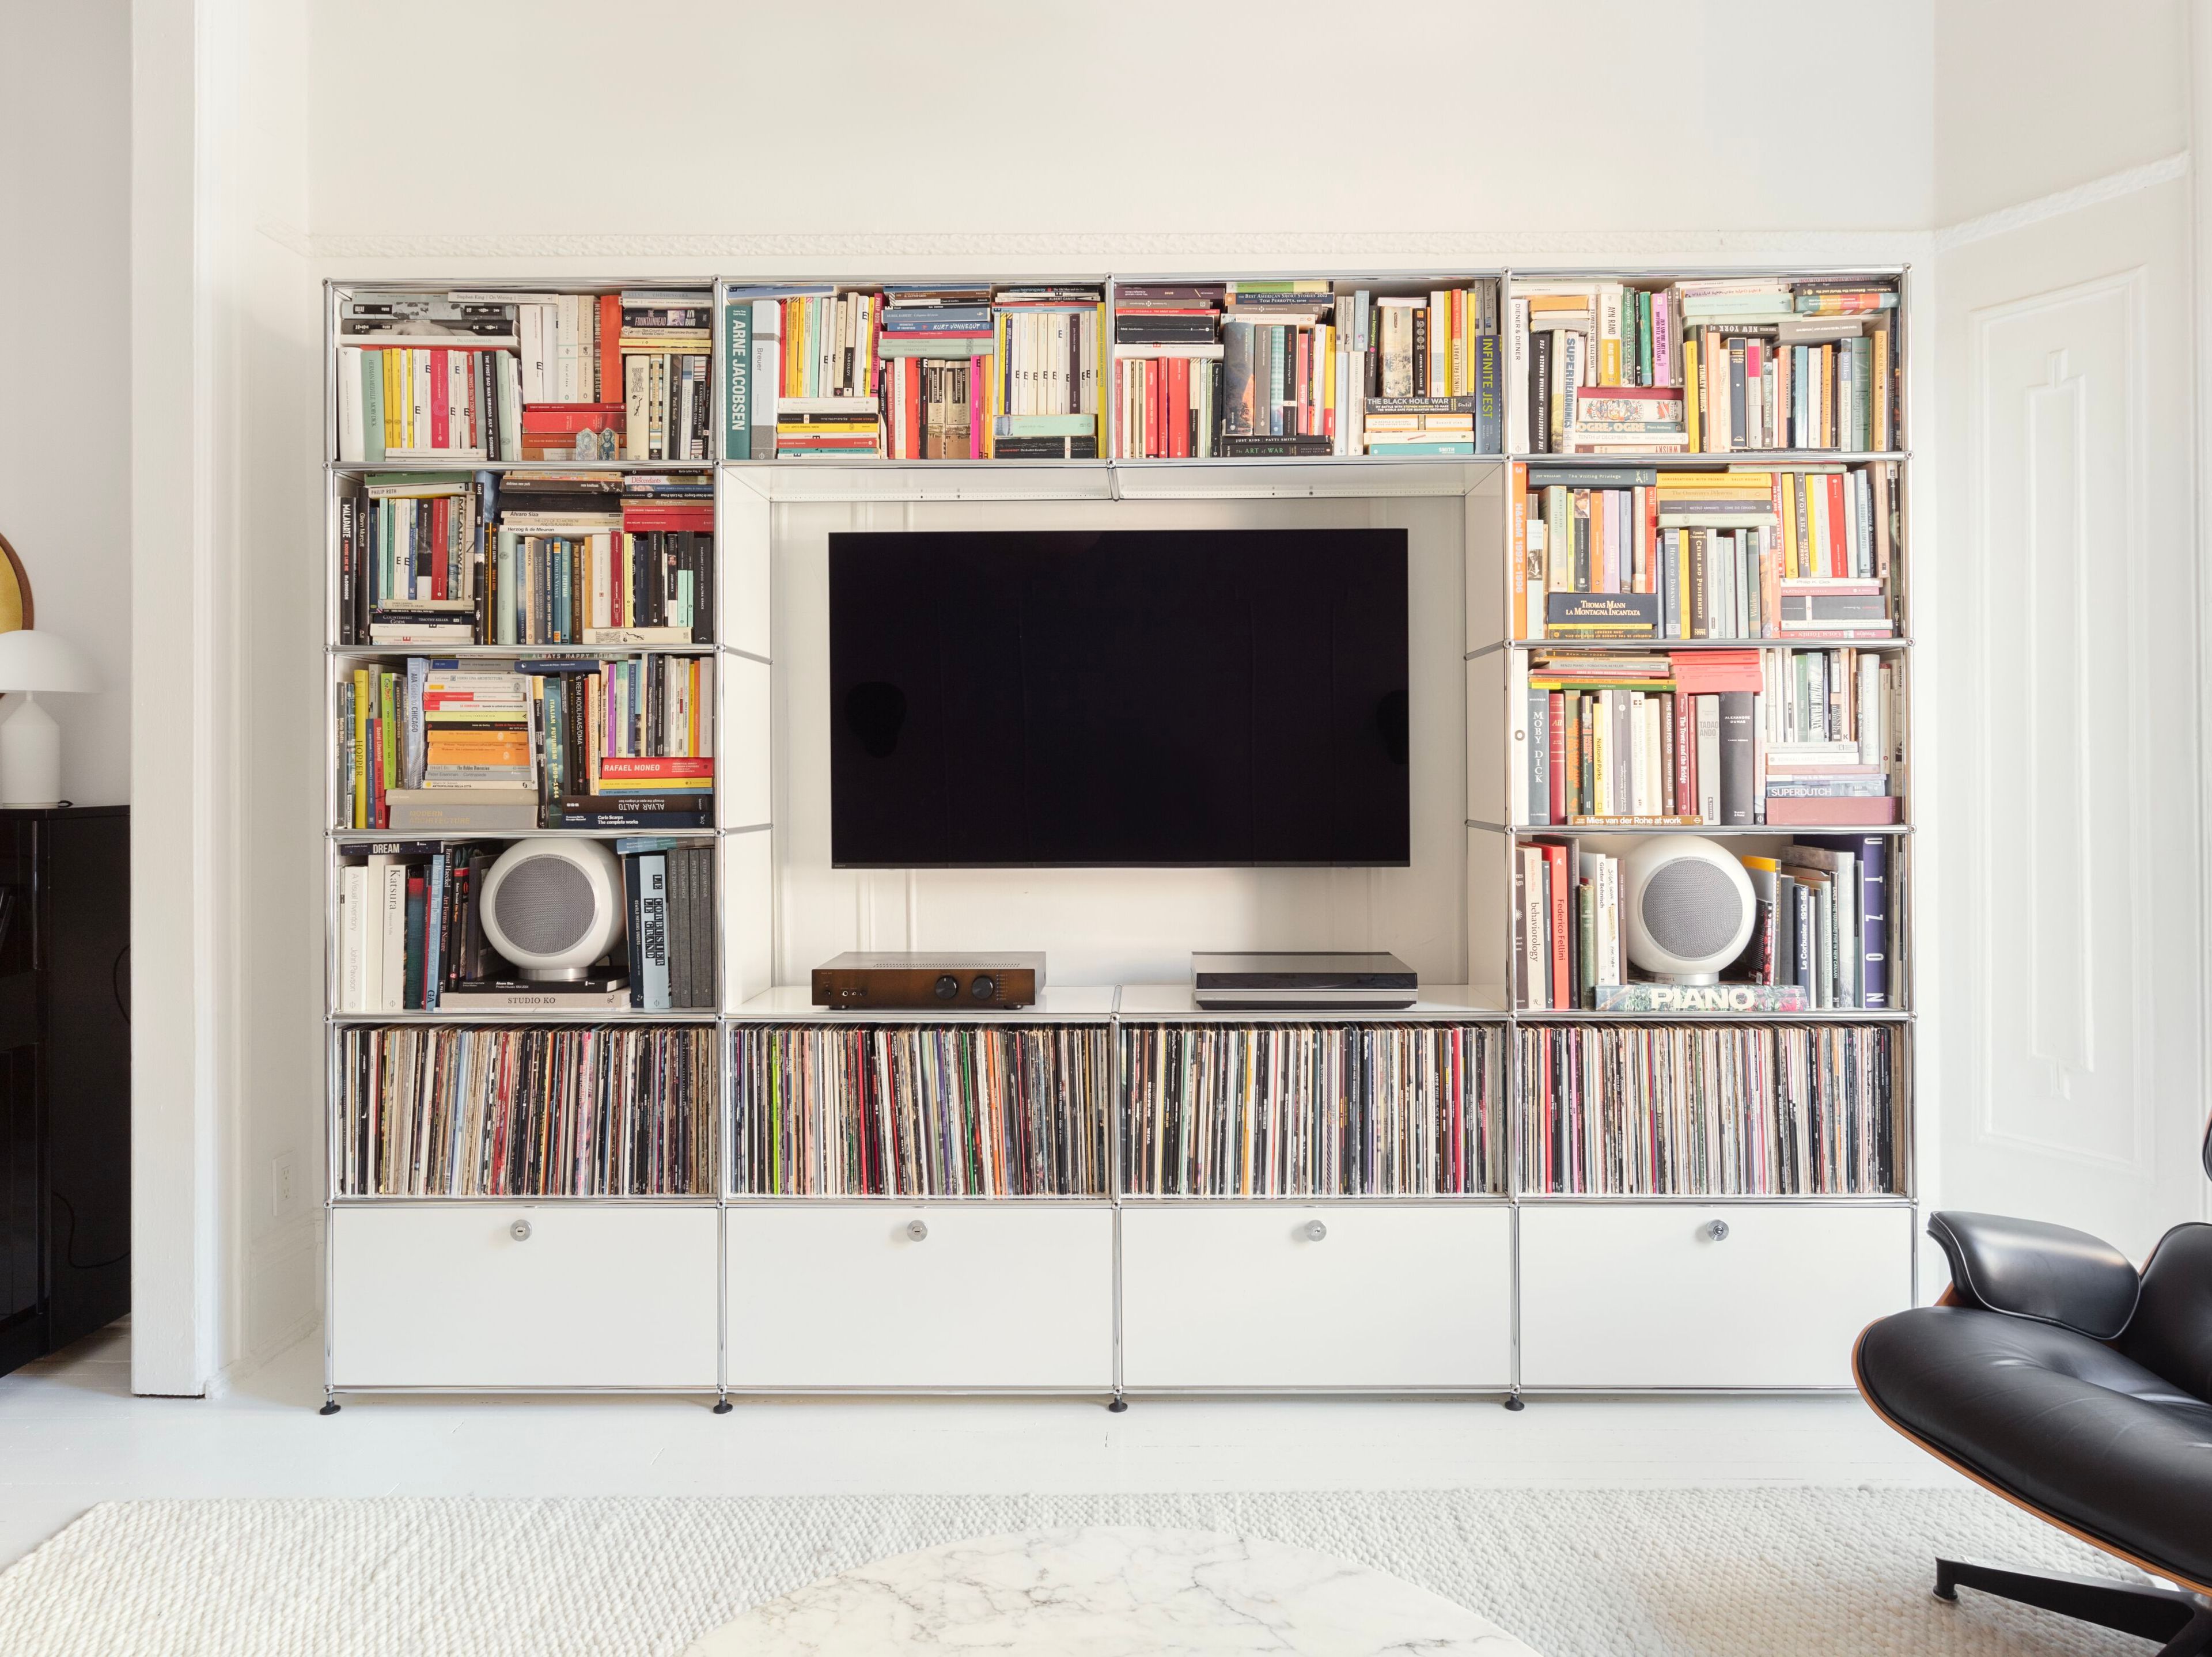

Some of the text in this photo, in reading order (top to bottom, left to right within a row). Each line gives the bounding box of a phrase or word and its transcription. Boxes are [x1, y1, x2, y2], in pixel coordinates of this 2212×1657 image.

[635, 317, 666, 326] FOUNTAINHEAD
[685, 317, 696, 326] RAND
[732, 320, 746, 430] ARNE JACOBSEN
[1482, 338, 1493, 419] INFINITE JEST
[1564, 338, 1575, 429] SUPERFREAKONOMICS
[1576, 422, 1646, 432] OGRE, OGRE
[1515, 503, 1523, 537] H&deM
[1669, 568, 1676, 577] OF
[1574, 608, 1608, 616] MONTAGNA
[1608, 608, 1641, 616] INCANTATA
[1581, 600, 1626, 609] THOMAS MANN
[1533, 711, 1544, 744] MOBY
[1535, 750, 1543, 783] DICK
[1771, 788, 1832, 797] SUPERDUTCH
[373, 843, 400, 854] DREAM
[444, 865, 452, 888] Haeckel
[653, 875, 662, 889] LE
[351, 880, 359, 900] Visual
[389, 869, 400, 910] Katsura
[350, 900, 359, 931] Inventory
[1864, 837, 1884, 1003] UTZON
[644, 898, 655, 958] LE GRAND
[654, 898, 665, 966] CORBUSIER
[1529, 902, 1540, 962] behaviorology
[1558, 935, 1566, 961] Fellini
[1800, 960, 1807, 970] Le
[350, 965, 358, 992] Pawson
[427, 989, 435, 1004] GA
[1651, 988, 1755, 1009] PIANO
